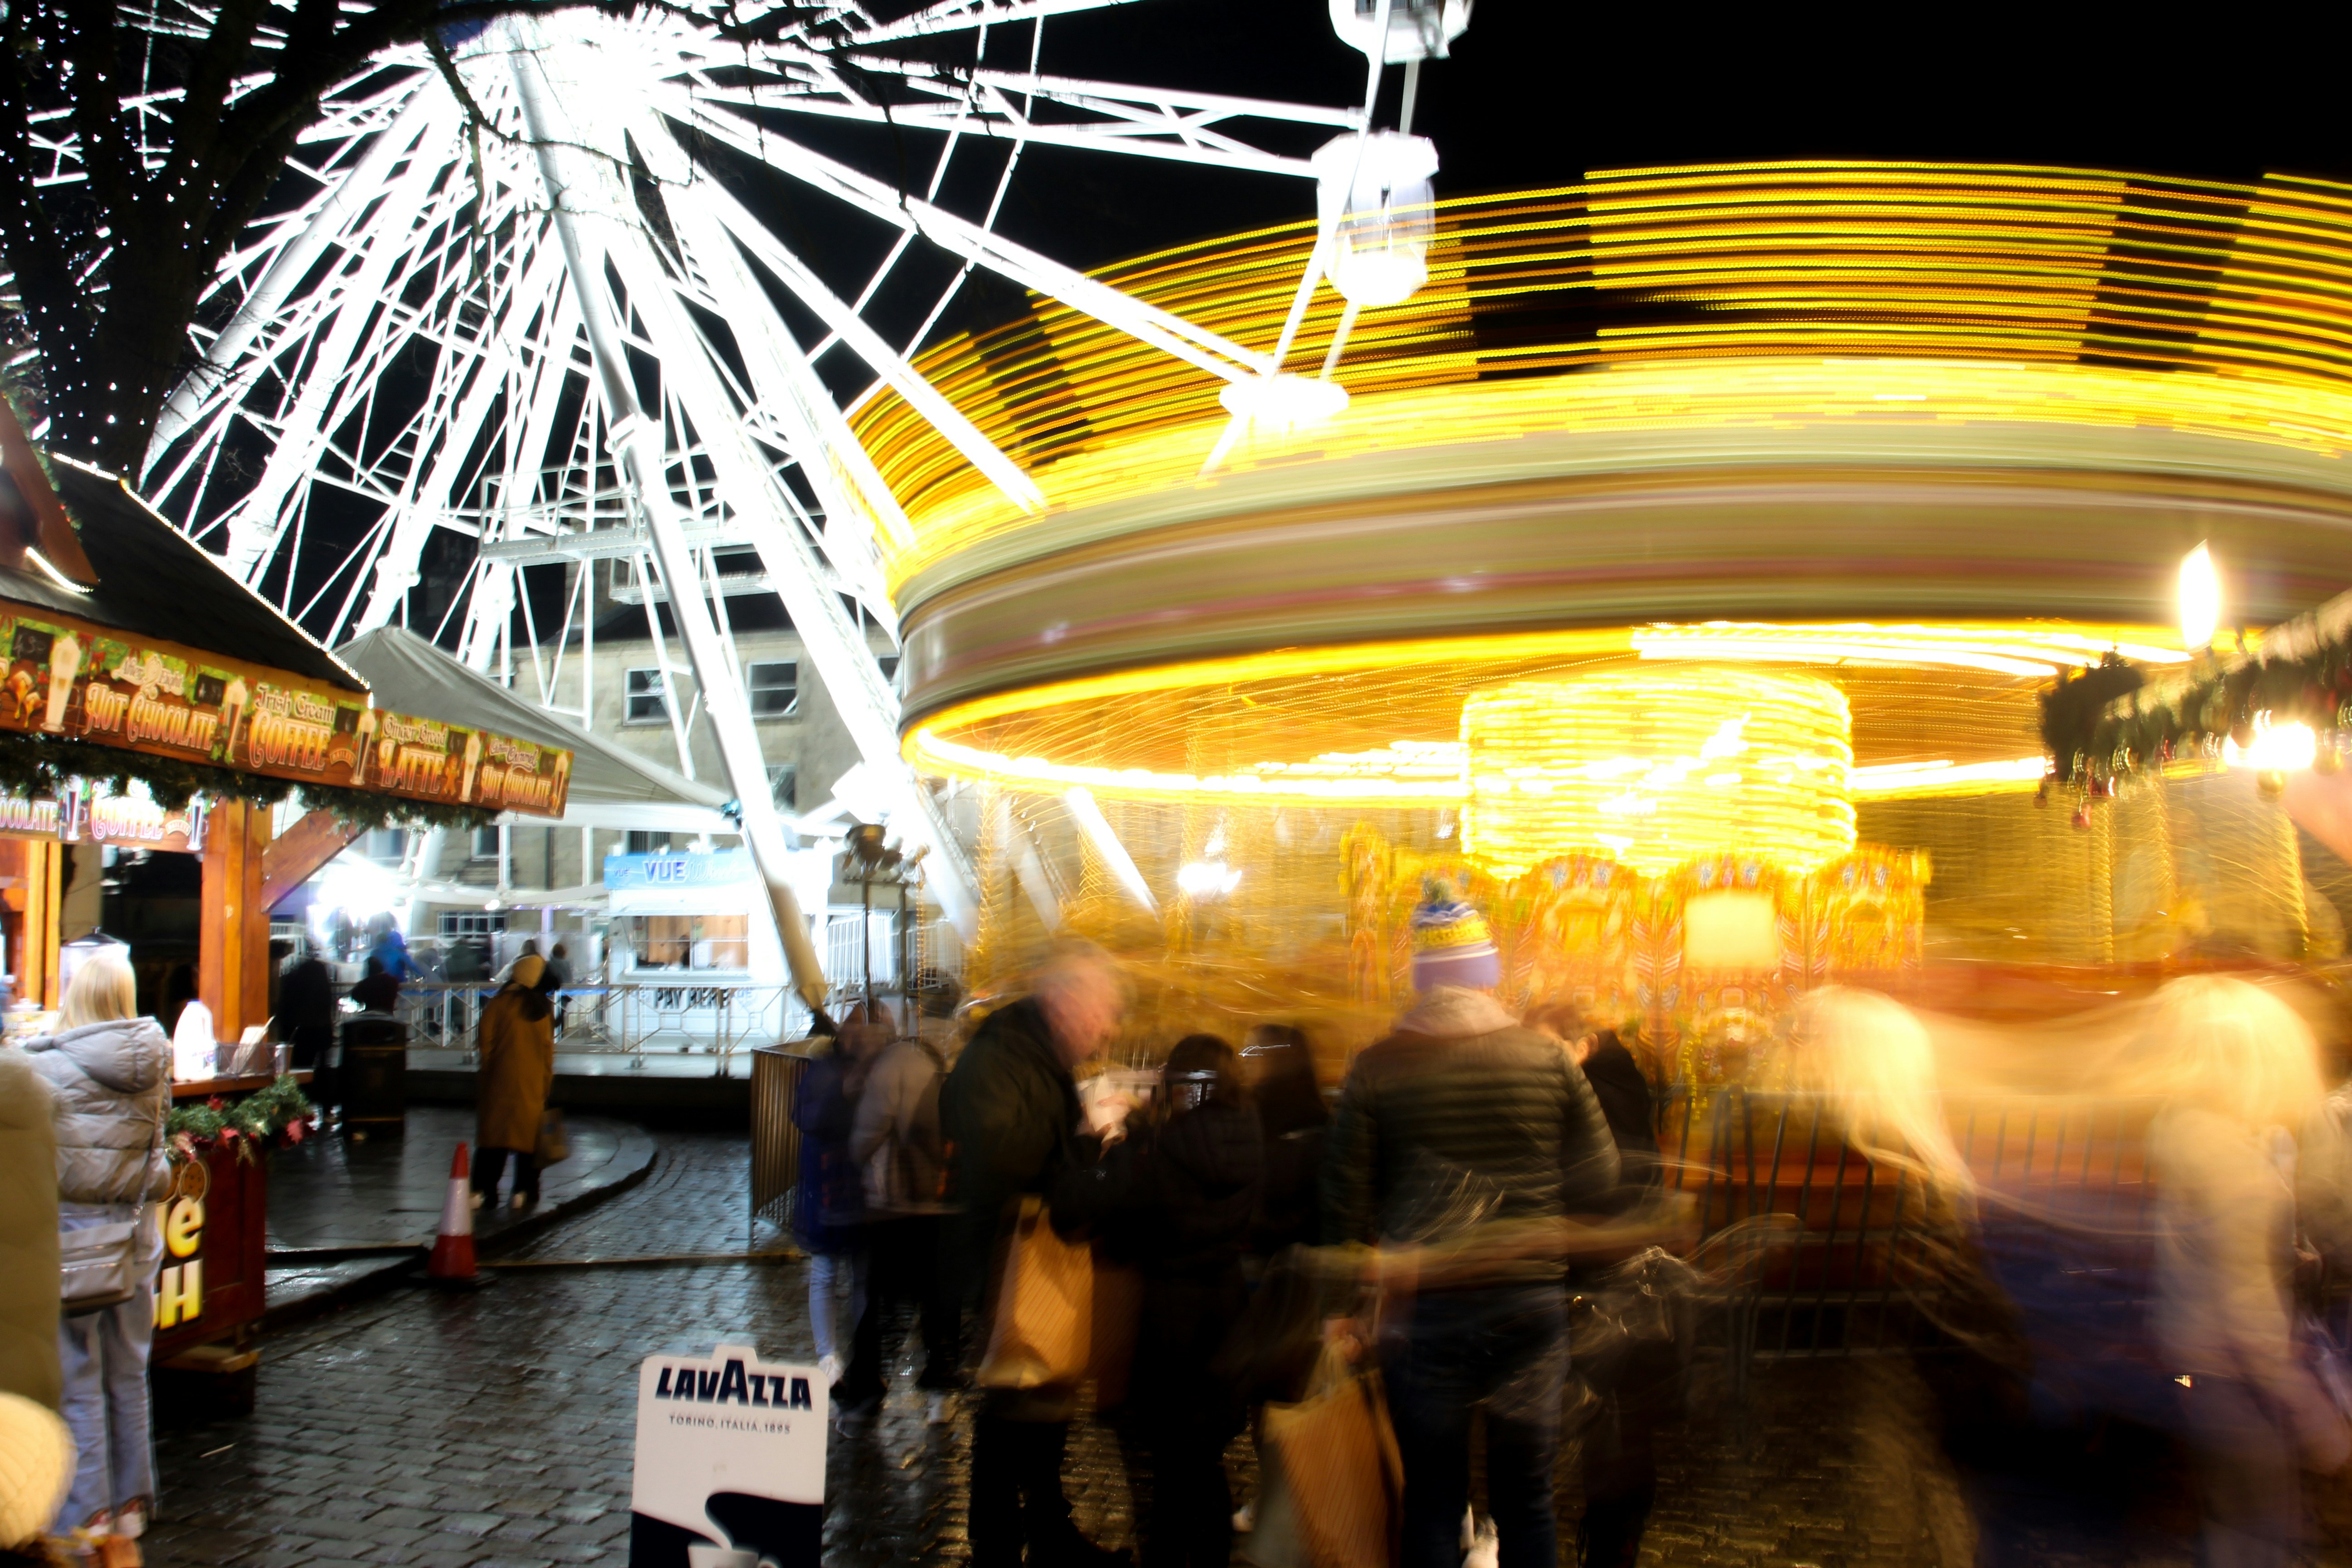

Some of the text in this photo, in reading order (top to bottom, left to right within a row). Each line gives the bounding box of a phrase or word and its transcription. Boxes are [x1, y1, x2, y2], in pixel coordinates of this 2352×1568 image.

[83, 682, 217, 751] HOT CHOCOLATE
[255, 683, 292, 718] Irish
[295, 693, 335, 723] Cream
[250, 710, 331, 771] COFFEE
[383, 714, 415, 745] Ginger
[418, 721, 447, 747] Bread
[379, 740, 445, 794] LATTE
[478, 765, 551, 807] HOT CHOCOLATE
[642, 861, 689, 883] VUE
[655, 1359, 812, 1411] LAVAZZA
[764, 1422, 790, 1435] 1895
